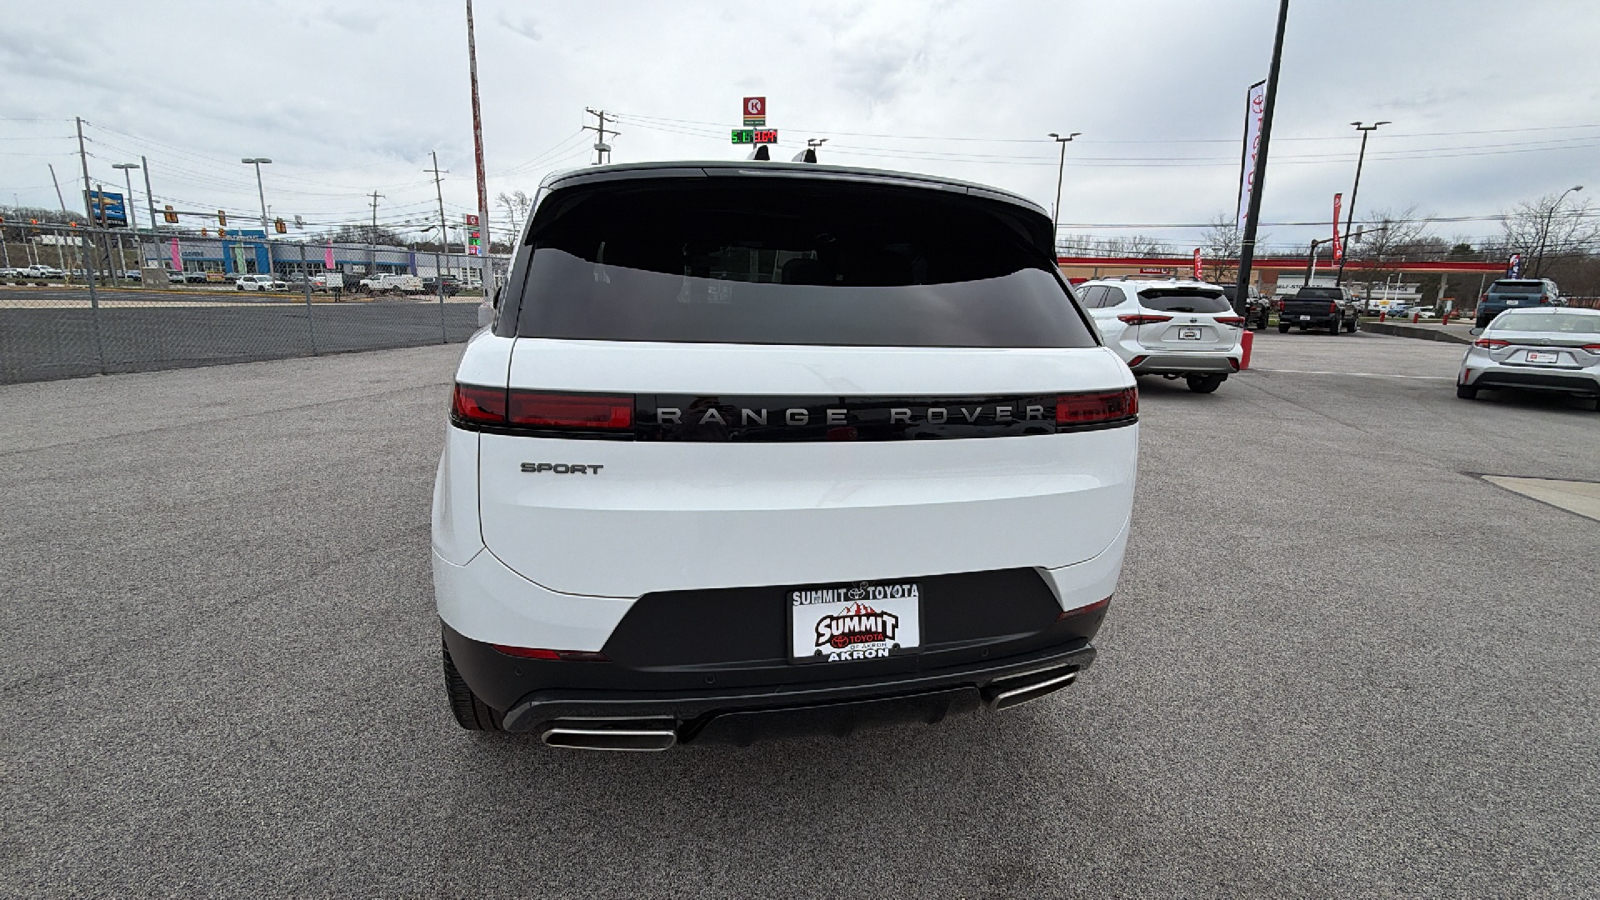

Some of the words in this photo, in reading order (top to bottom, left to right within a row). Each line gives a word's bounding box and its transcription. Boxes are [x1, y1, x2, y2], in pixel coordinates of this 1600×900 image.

[656, 407, 848, 425] RANGE
[890, 405, 1045, 424] ROVER
[520, 462, 604, 475] SPORT
[792, 588, 847, 606] SUMMIT
[867, 583, 919, 600] TOYOTA
[817, 614, 896, 644] SUMMIT
[849, 633, 884, 643] TOYOTA
[828, 648, 889, 662] AKRON
